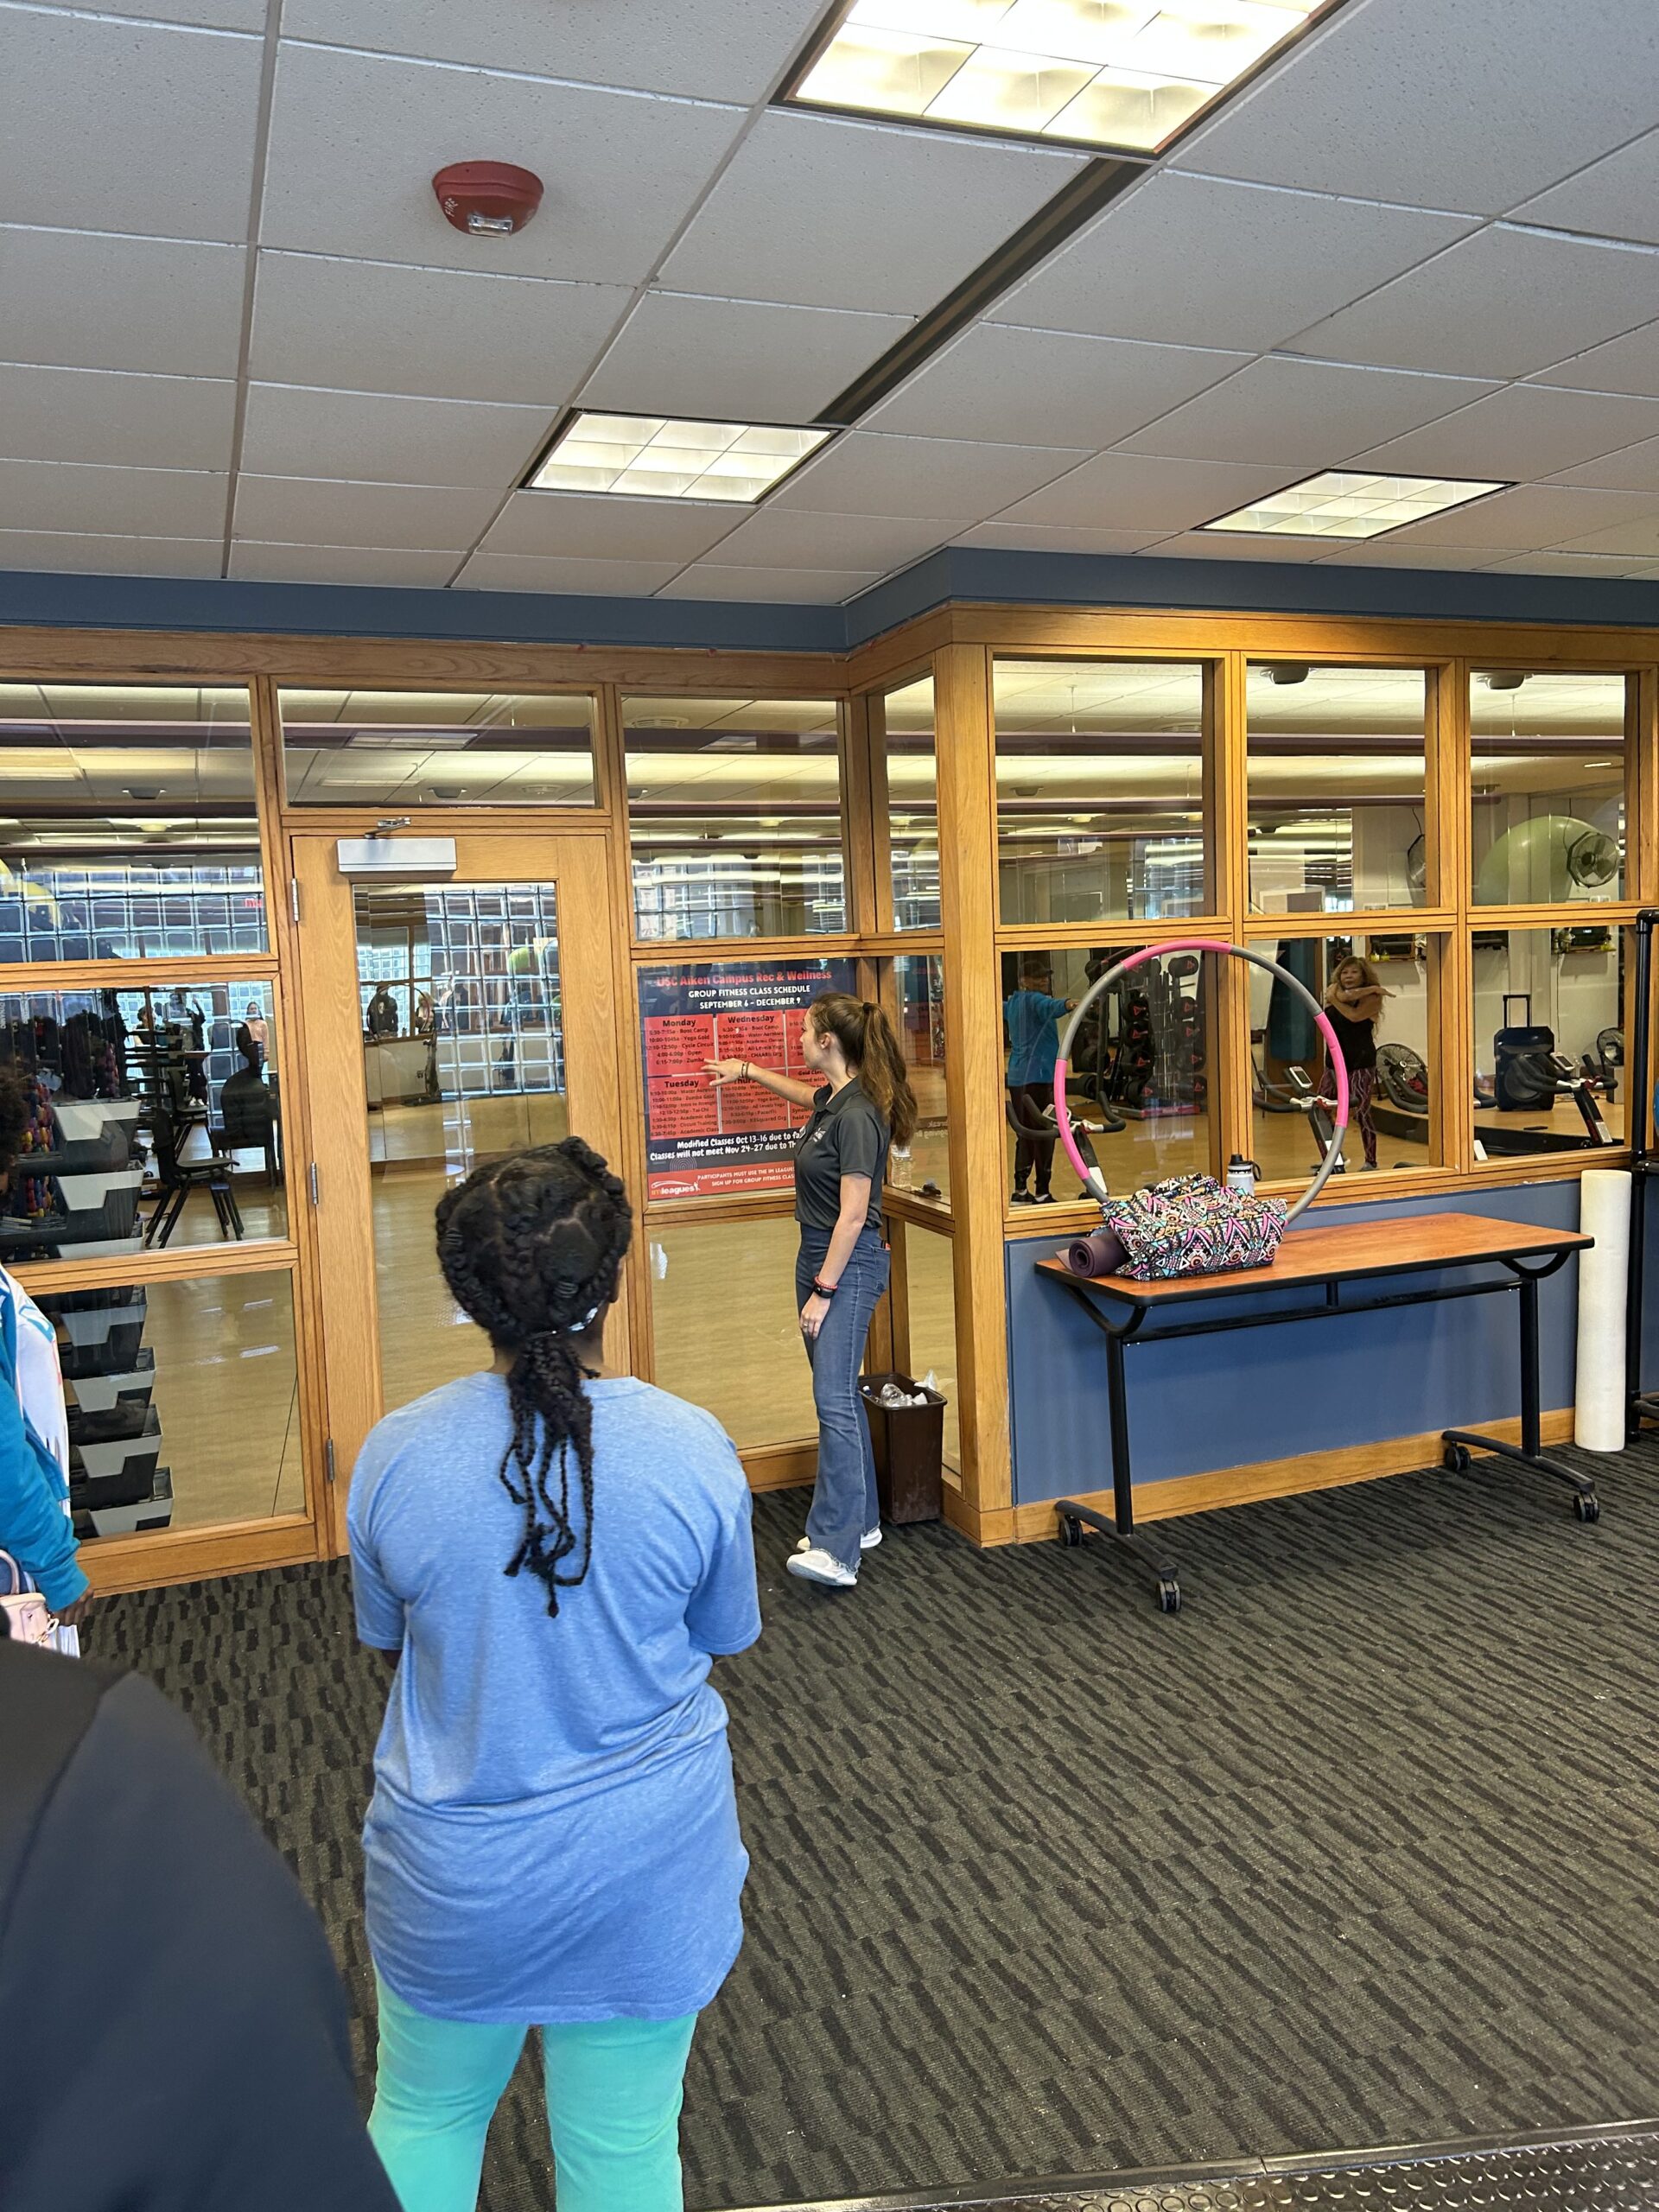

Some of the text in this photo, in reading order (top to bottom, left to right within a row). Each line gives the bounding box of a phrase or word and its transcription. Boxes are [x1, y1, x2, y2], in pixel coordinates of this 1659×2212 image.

[444, 198, 459, 217] FIRE
[657, 976, 677, 986] USC
[680, 976, 710, 985] Aiken
[713, 974, 753, 984] Campus
[777, 972, 784, 982] &
[787, 970, 832, 981] Wellness
[689, 985, 810, 998] GROUP FITNESS CLASS SCHEDULE
[700, 1000, 742, 1009] SEPTEMBER
[756, 997, 794, 1007] DECEMBER
[663, 1019, 696, 1027] Monday
[728, 1014, 774, 1023] Wednesday
[664, 1079, 699, 1088] Tuesday
[677, 1139, 709, 1149] Modified
[710, 1137, 734, 1147] Classes
[749, 1135, 767, 1143] 13-16
[650, 1152, 675, 1160] Classes
[706, 1147, 724, 1155] meet
[725, 1145, 740, 1154] Nov
[741, 1143, 764, 1153] 24-27
[765, 1141, 779, 1150] due
[779, 1141, 786, 1149] to
